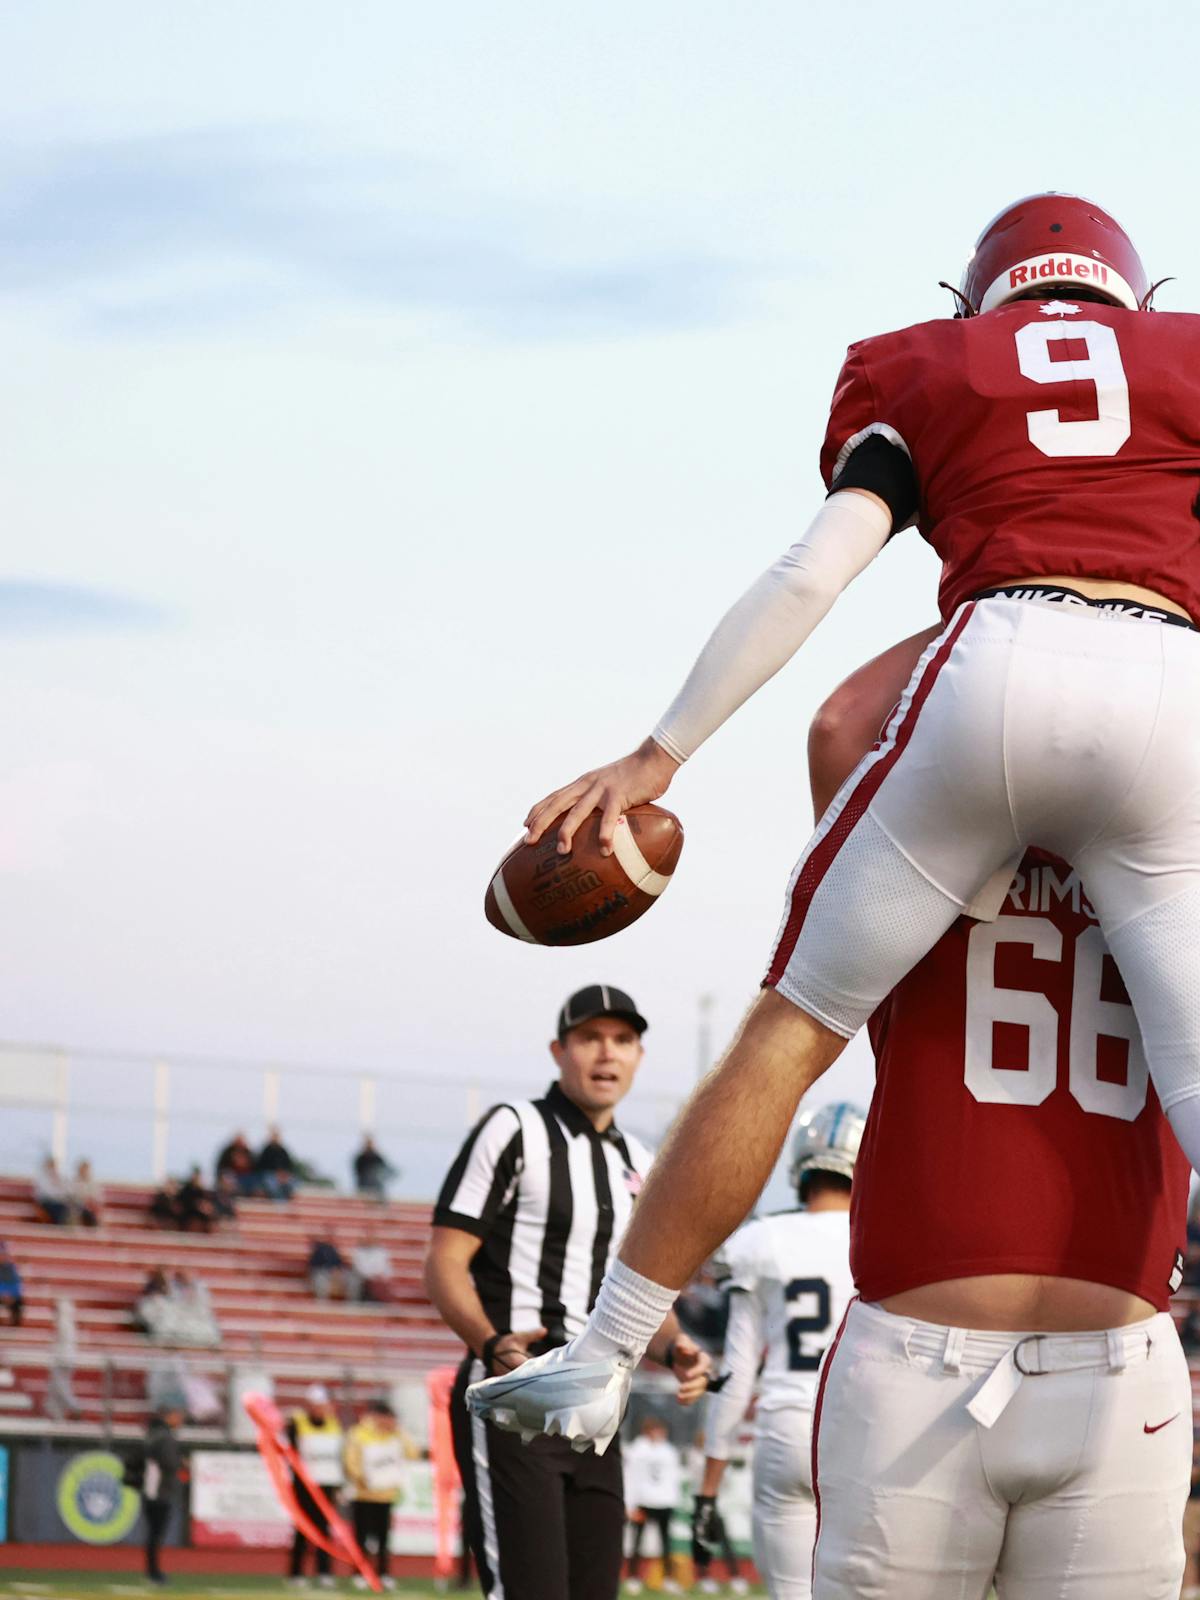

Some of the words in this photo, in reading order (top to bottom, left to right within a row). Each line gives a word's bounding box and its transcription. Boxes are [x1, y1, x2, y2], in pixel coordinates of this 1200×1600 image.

[1009, 257, 1108, 289] Riddell
[1013, 320, 1131, 457] 9
[964, 914, 1150, 1123] 66
[784, 1277, 831, 1372] 2
